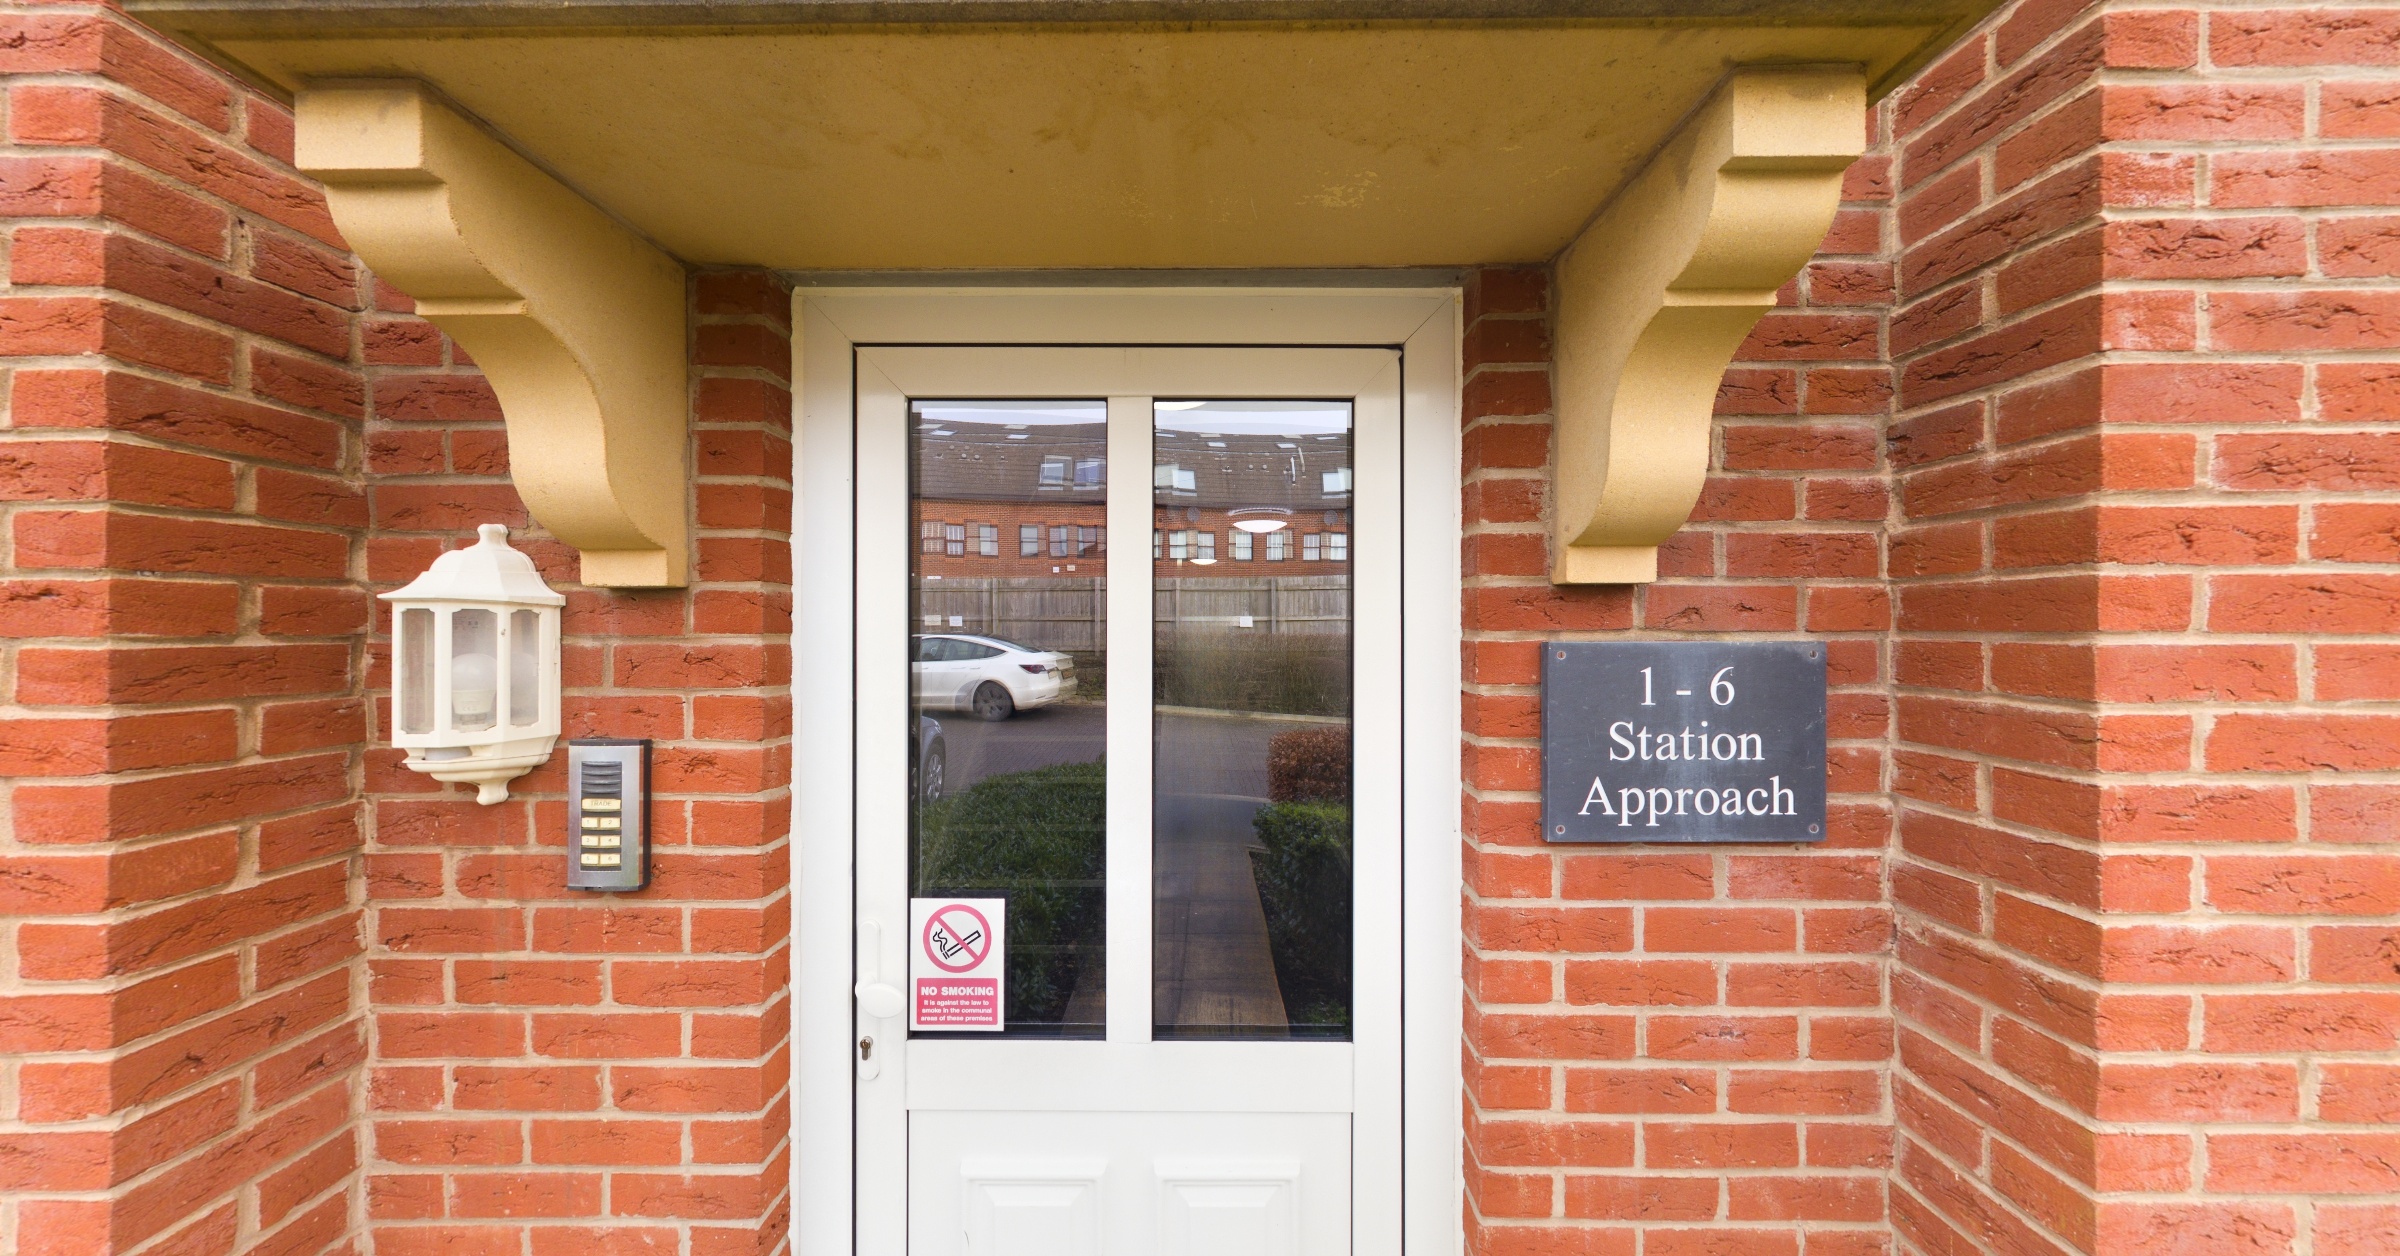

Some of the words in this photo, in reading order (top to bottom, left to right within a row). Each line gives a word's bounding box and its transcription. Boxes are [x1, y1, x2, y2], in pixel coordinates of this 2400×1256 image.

[1640, 667, 1656, 706] 1
[1710, 666, 1735, 706] 6
[1609, 721, 1765, 761] Station
[1578, 775, 1797, 827] Approach
[921, 986, 938, 996] NO
[941, 986, 994, 996] SMOKING
[936, 999, 959, 1007] against
[965, 1015, 993, 1023] premises
